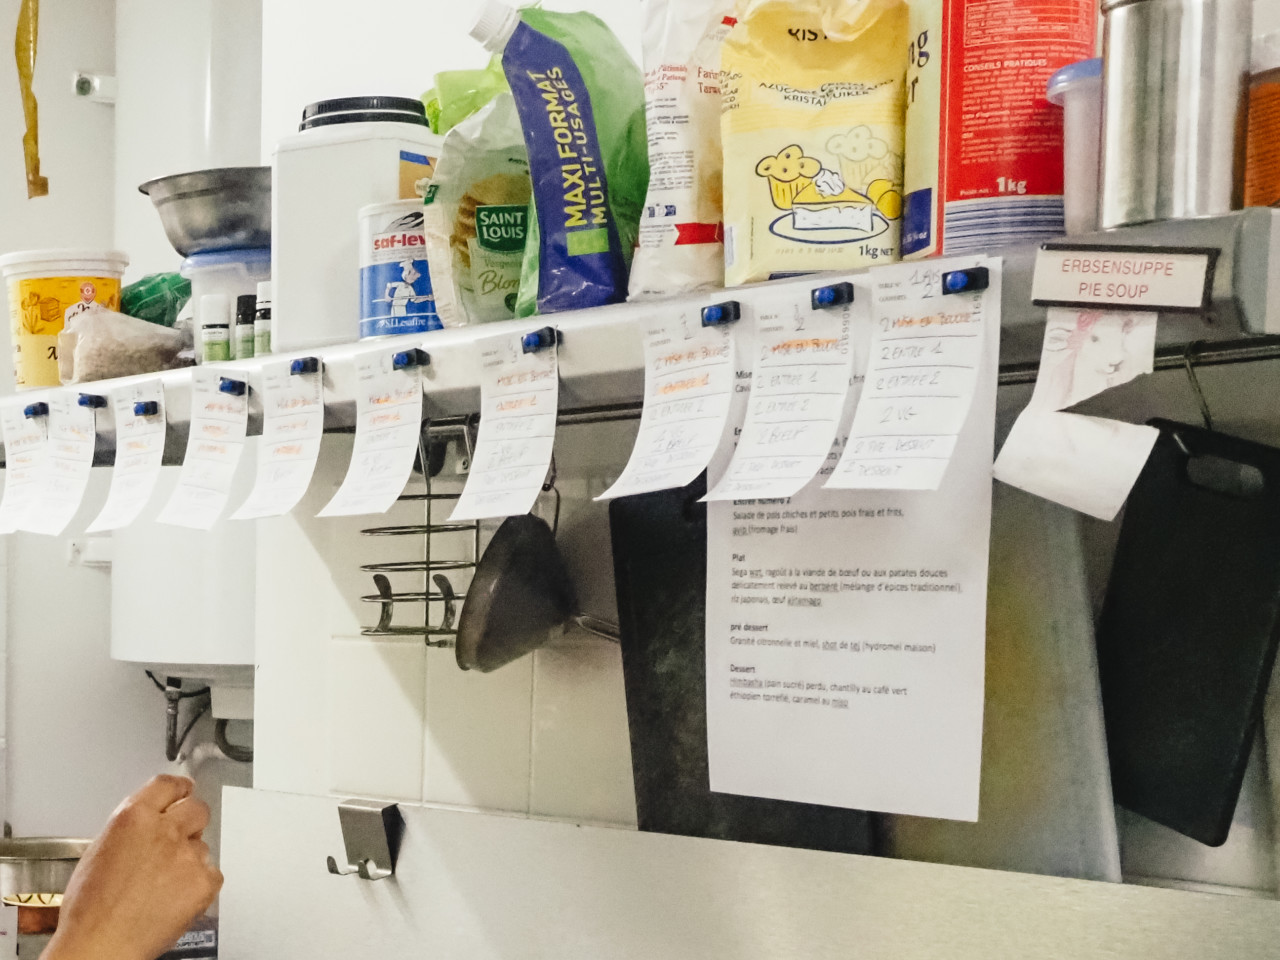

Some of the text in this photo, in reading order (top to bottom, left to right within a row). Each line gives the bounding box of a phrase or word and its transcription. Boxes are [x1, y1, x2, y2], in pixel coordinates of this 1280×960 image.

[963, 58, 1048, 73] CONSEILS PRATIQUES
[526, 70, 588, 227] MAXI FORMAT
[547, 66, 607, 224] MULTI-USAGES
[479, 211, 524, 225] SAINT
[374, 233, 426, 251] saf-lev
[482, 226, 524, 242] LOUIS
[880, 247, 895, 256] NET
[1061, 258, 1175, 276] ERBSENSUPPE
[479, 269, 520, 296] Blon
[1078, 282, 1149, 298] PIE SOUP
[732, 553, 746, 562] Plat
[743, 623, 768, 632] dessert
[730, 664, 756, 673] Dessert
